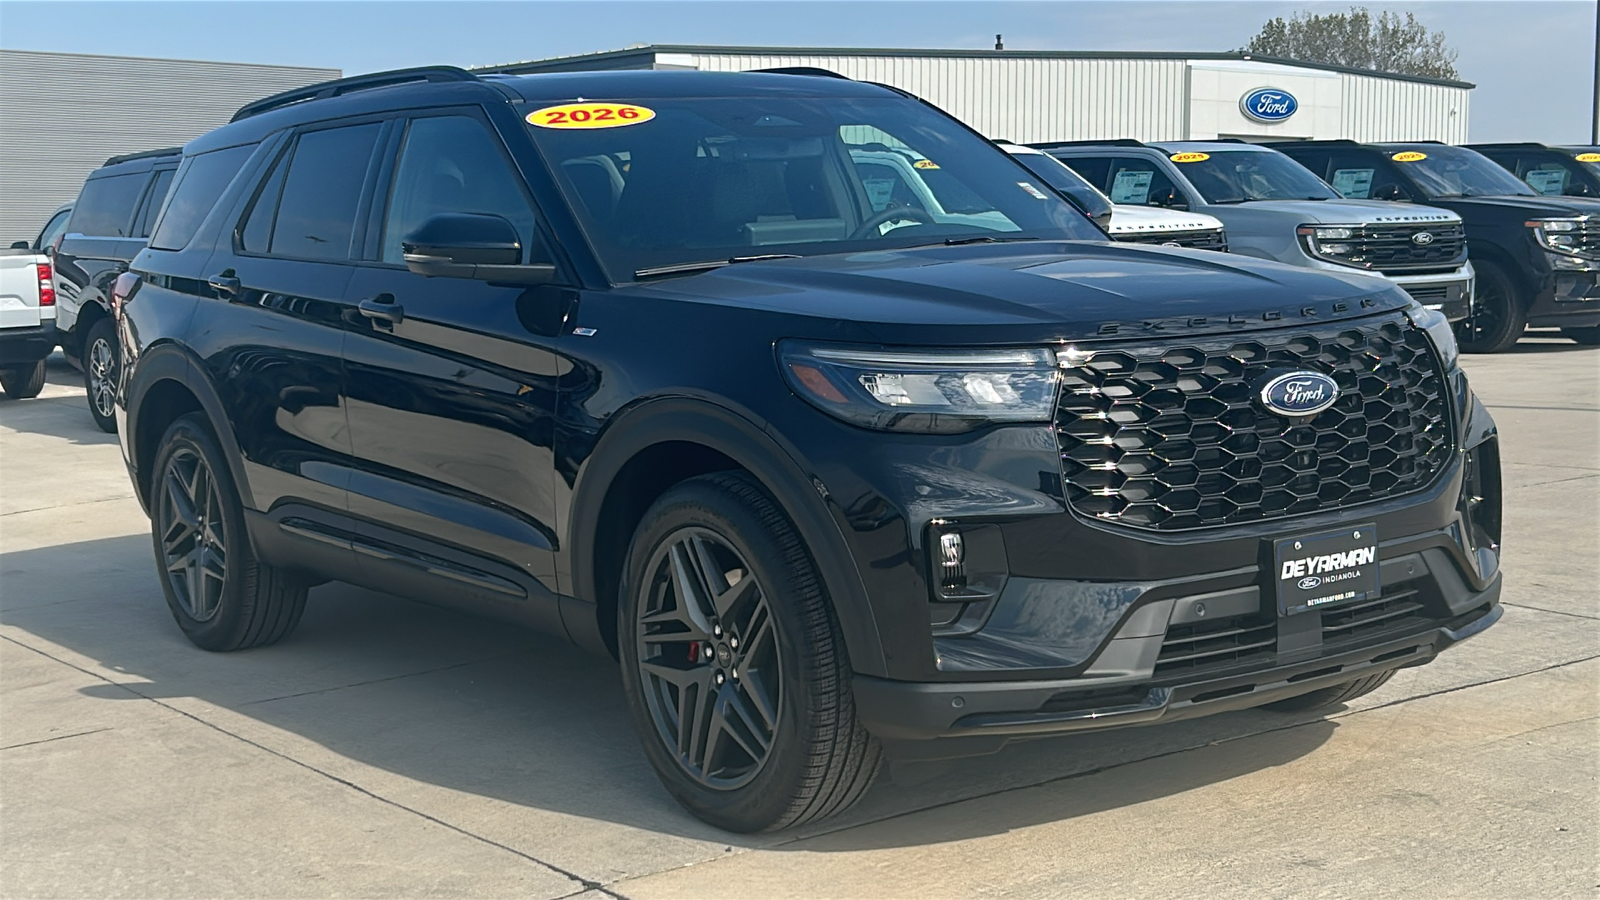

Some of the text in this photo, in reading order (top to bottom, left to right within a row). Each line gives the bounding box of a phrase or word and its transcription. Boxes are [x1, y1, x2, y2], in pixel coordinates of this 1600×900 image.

[1257, 94, 1289, 114] Ford
[545, 107, 639, 125] 2026
[1176, 153, 1204, 161] 2025
[1398, 152, 1422, 161] 2025
[1116, 222, 1204, 230] EXPEDITION
[1096, 298, 1378, 335] EXPLORER
[1284, 380, 1325, 405] Ford
[1281, 546, 1376, 580] DEYARMAN
[1322, 570, 1361, 584] INDIANOLA
